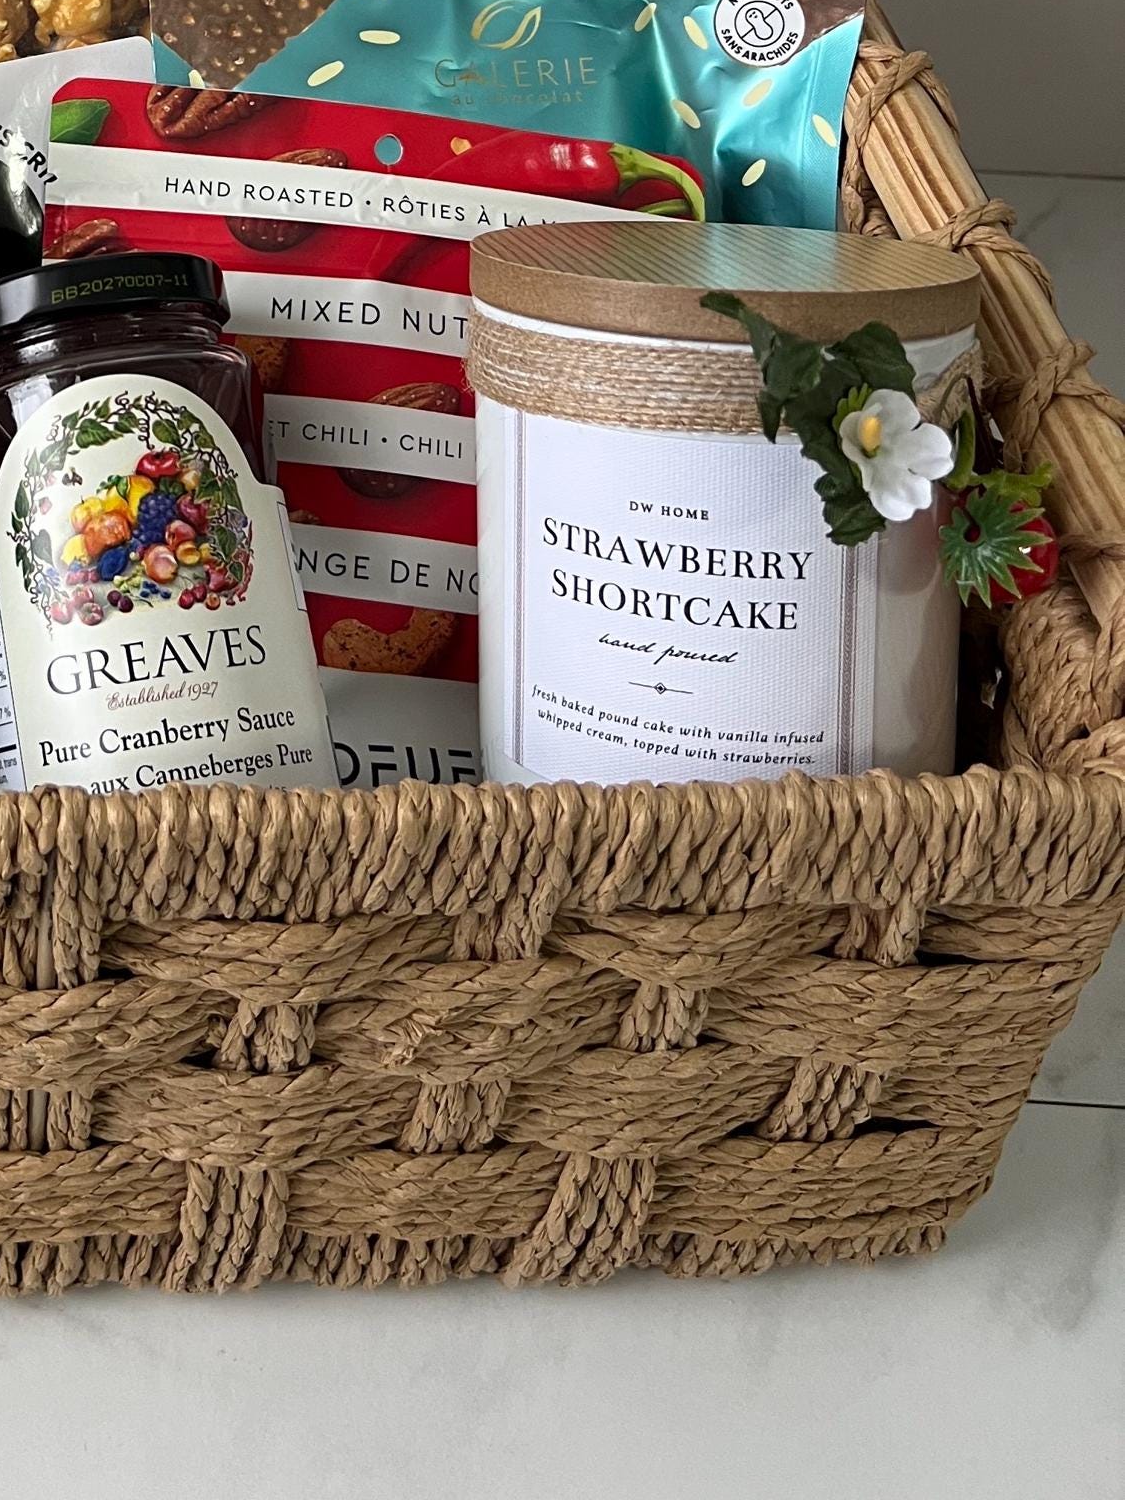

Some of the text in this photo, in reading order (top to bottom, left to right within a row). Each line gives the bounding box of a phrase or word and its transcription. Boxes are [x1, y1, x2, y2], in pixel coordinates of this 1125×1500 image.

[721, 28, 799, 62] SANS ARACHIDES
[164, 176, 232, 198] HAND
[243, 183, 354, 209] ROASTED
[381, 194, 466, 223] RÔTIES
[477, 204, 491, 226] À
[271, 296, 469, 340] MIXED NUT
[301, 422, 369, 447] CHILI
[399, 434, 463, 459] CHILI
[629, 500, 710, 521] DW HOME
[542, 516, 814, 581] STRAWBERRY
[389, 559, 431, 588] DE
[551, 568, 798, 631] SHORTCAKE
[46, 624, 267, 696] GREAVES
[598, 632, 739, 666] hand poured
[105, 680, 219, 712] Established 1927
[531, 684, 825, 747] fresh baked pound cake with vanilla infused
[38, 705, 296, 768] Pure Cranberry Sauce
[537, 708, 816, 765] whipped cream, topped with strawberries.
[90, 774, 130, 795] aux
[135, 751, 274, 788] Canneberges
[276, 743, 313, 767] Pure
[333, 741, 477, 788] DFUE
